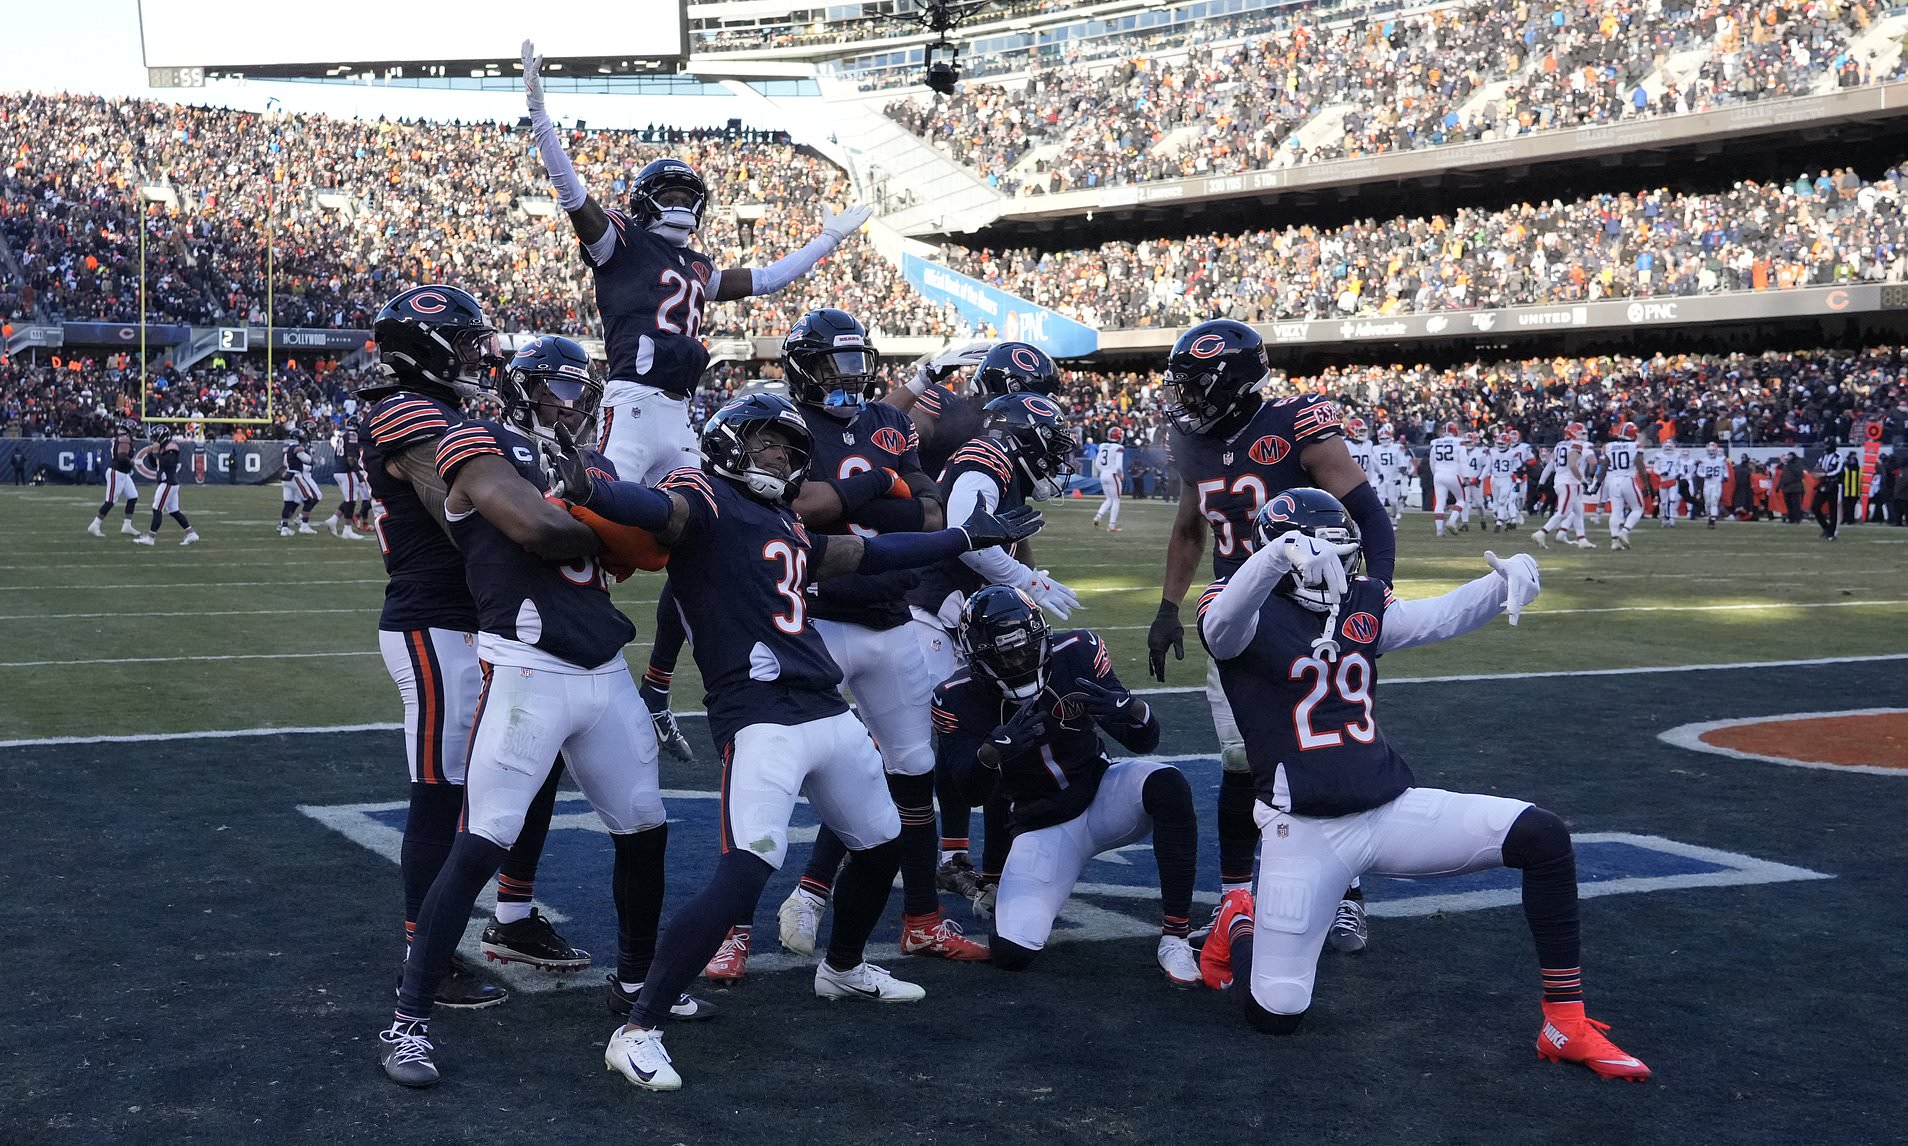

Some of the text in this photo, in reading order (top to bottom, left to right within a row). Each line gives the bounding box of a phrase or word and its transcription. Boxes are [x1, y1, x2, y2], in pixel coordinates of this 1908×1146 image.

[409, 292, 448, 314] C
[656, 268, 705, 339] 26
[1826, 290, 1849, 310] C
[1518, 311, 1571, 326] UNITED
[1645, 304, 1678, 319] PNC
[119, 328, 135, 340] C
[1019, 310, 1049, 341] PNC
[283, 333, 326, 345] HOLLYWOOD
[1189, 334, 1226, 359] C
[1012, 348, 1040, 372] C
[1023, 396, 1054, 417] C
[511, 446, 534, 462] C
[1101, 449, 1108, 466] 3
[1380, 452, 1393, 466] 51
[1435, 444, 1454, 461] 52
[1611, 451, 1630, 470] 10
[1469, 457, 1477, 471] 4
[1494, 459, 1510, 472] 43
[1197, 473, 1269, 557] 53
[1267, 495, 1296, 523] C
[1289, 651, 1376, 752] 29
[1542, 1020, 1569, 1051] NIKE
